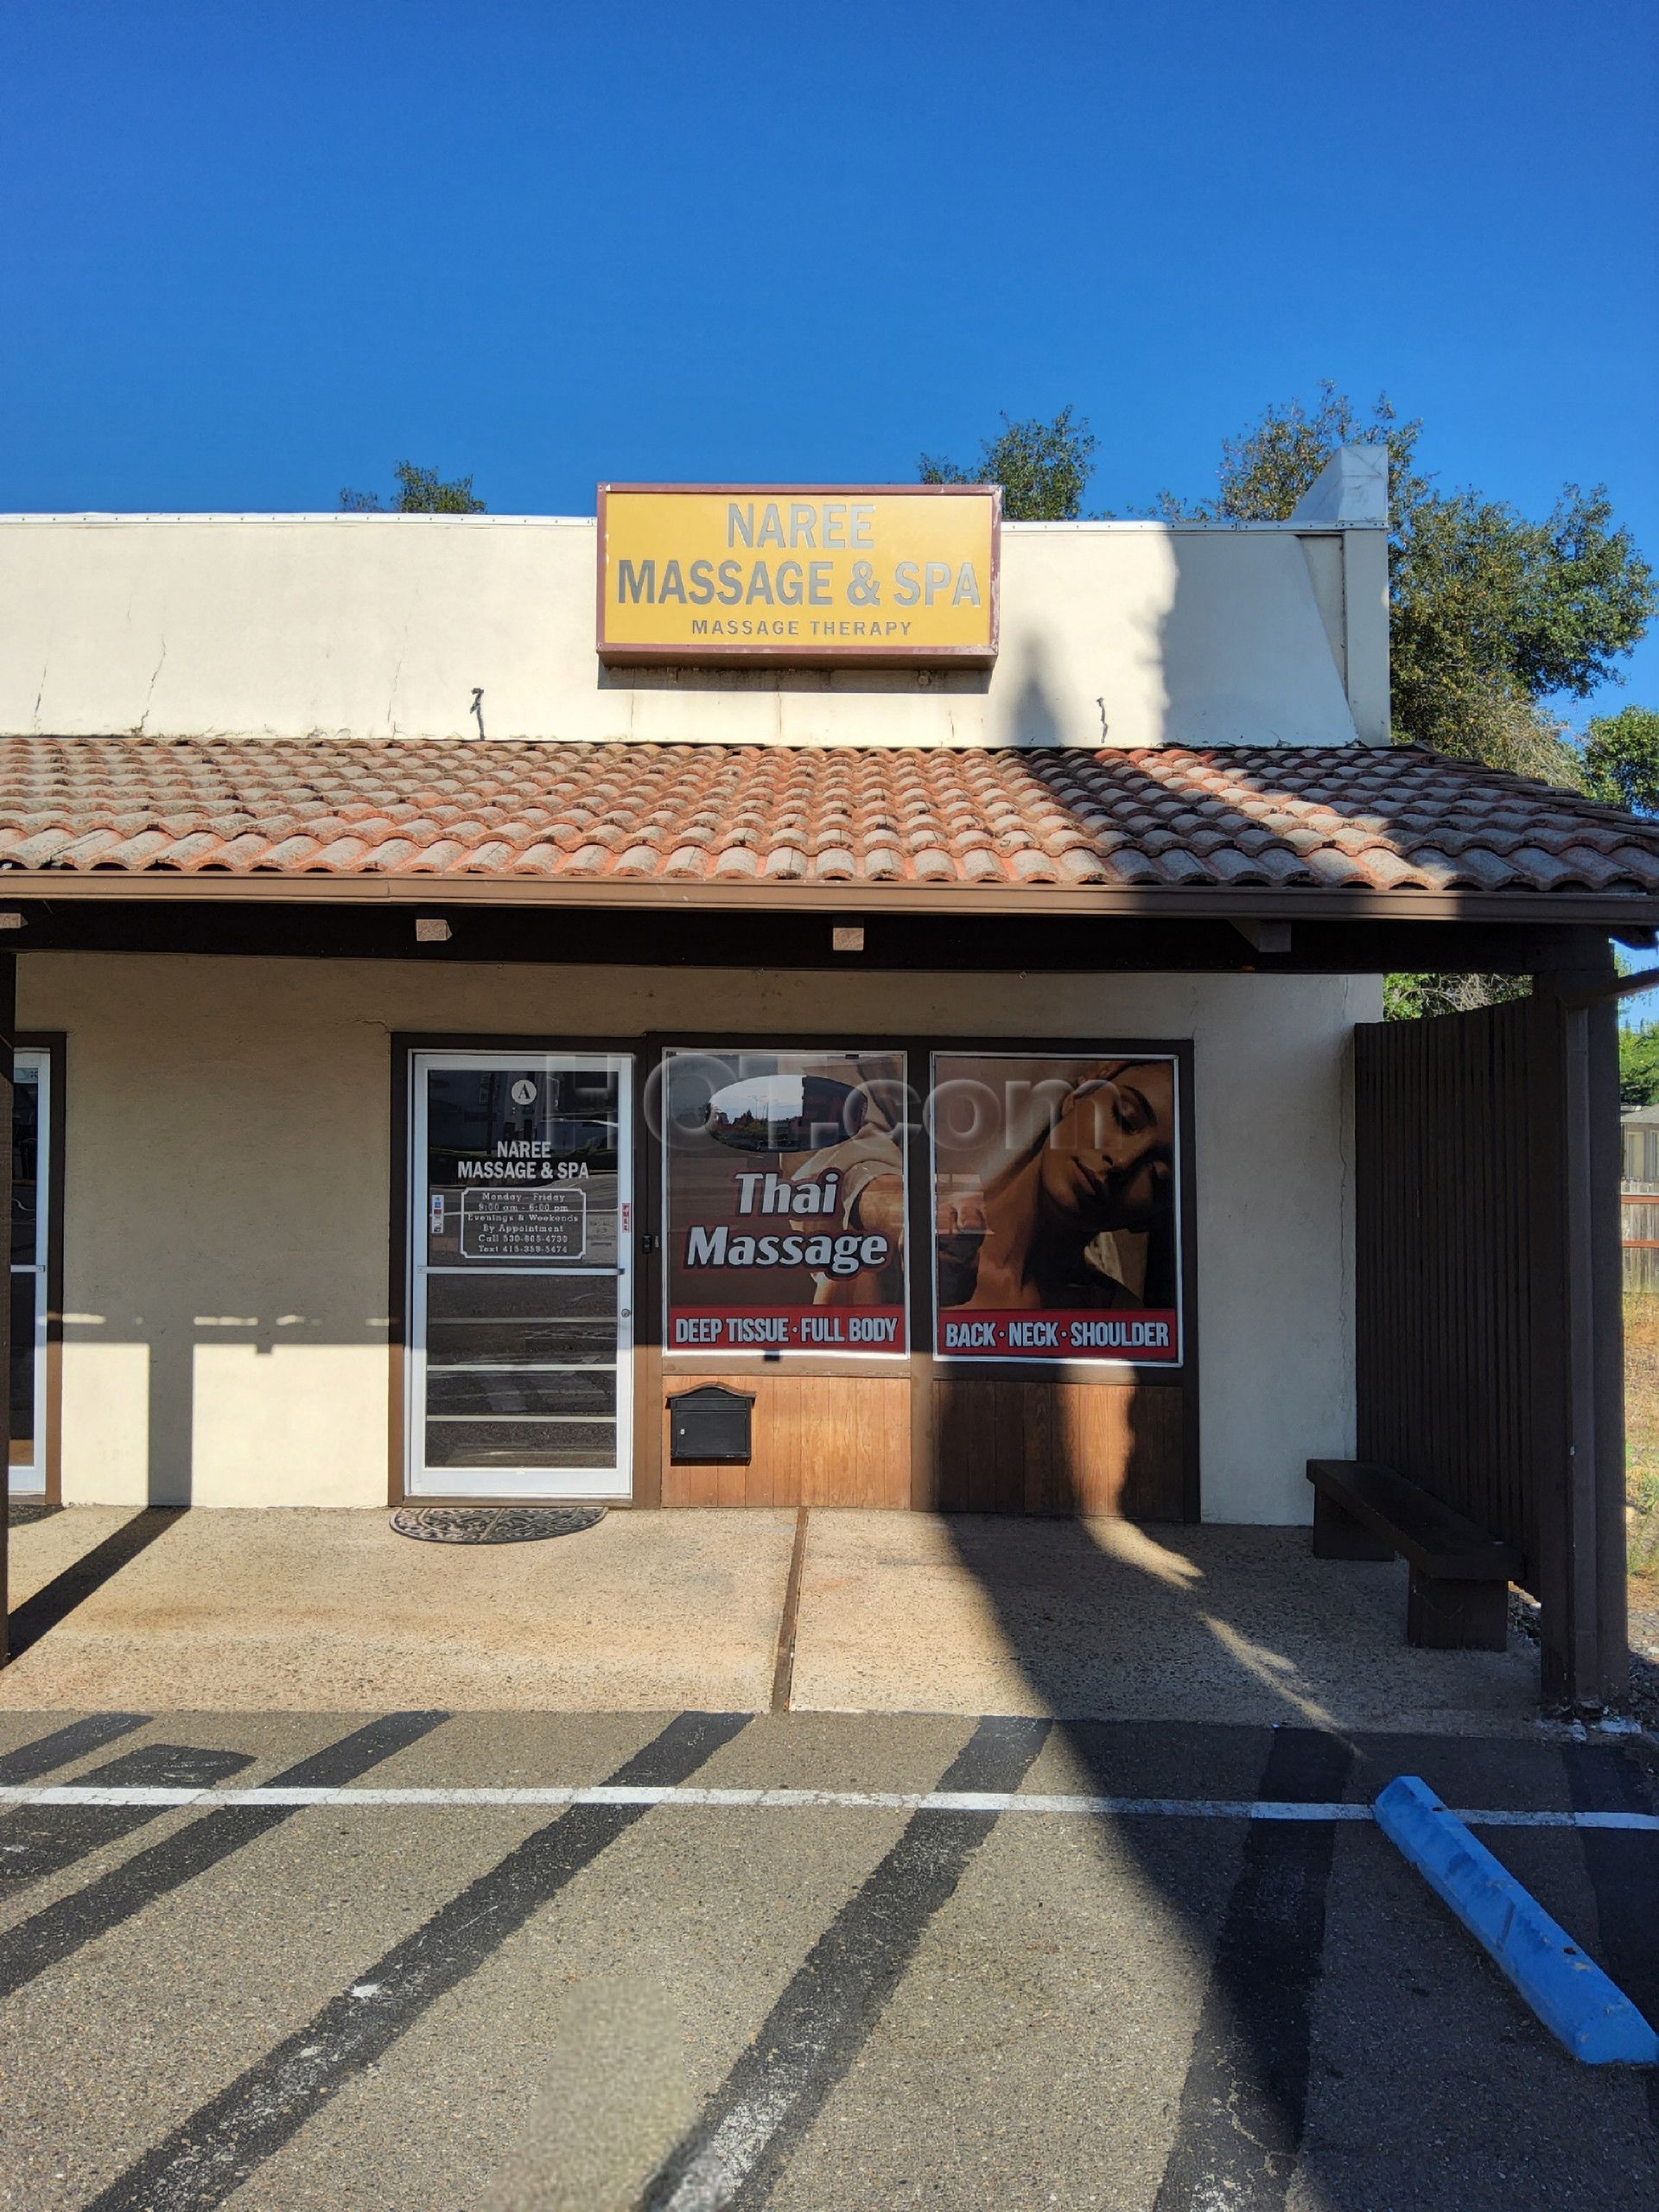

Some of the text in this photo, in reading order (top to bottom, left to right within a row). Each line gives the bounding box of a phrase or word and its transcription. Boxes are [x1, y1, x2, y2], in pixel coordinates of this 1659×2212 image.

[727, 503, 875, 549] NAREE
[617, 558, 982, 607] MASSAGE & SPA
[691, 620, 912, 636] MASSAGE THERAPY
[497, 1140, 551, 1159] NAREE
[457, 1160, 589, 1179] MASSAGE & SPA
[481, 1192, 523, 1203] Monday
[532, 1192, 566, 1203] Friday
[734, 1172, 841, 1214] Thai
[467, 1213, 514, 1223] Evenings
[528, 1213, 579, 1223] Weekends
[482, 1224, 564, 1233] By Appointment
[478, 1234, 499, 1243] Call
[478, 1244, 499, 1253] Text
[687, 1225, 887, 1274] Massage
[675, 1317, 898, 1344] DEEP TISSUE FULL BODY
[944, 1321, 1170, 1348] BACK NECK SHOULDER
